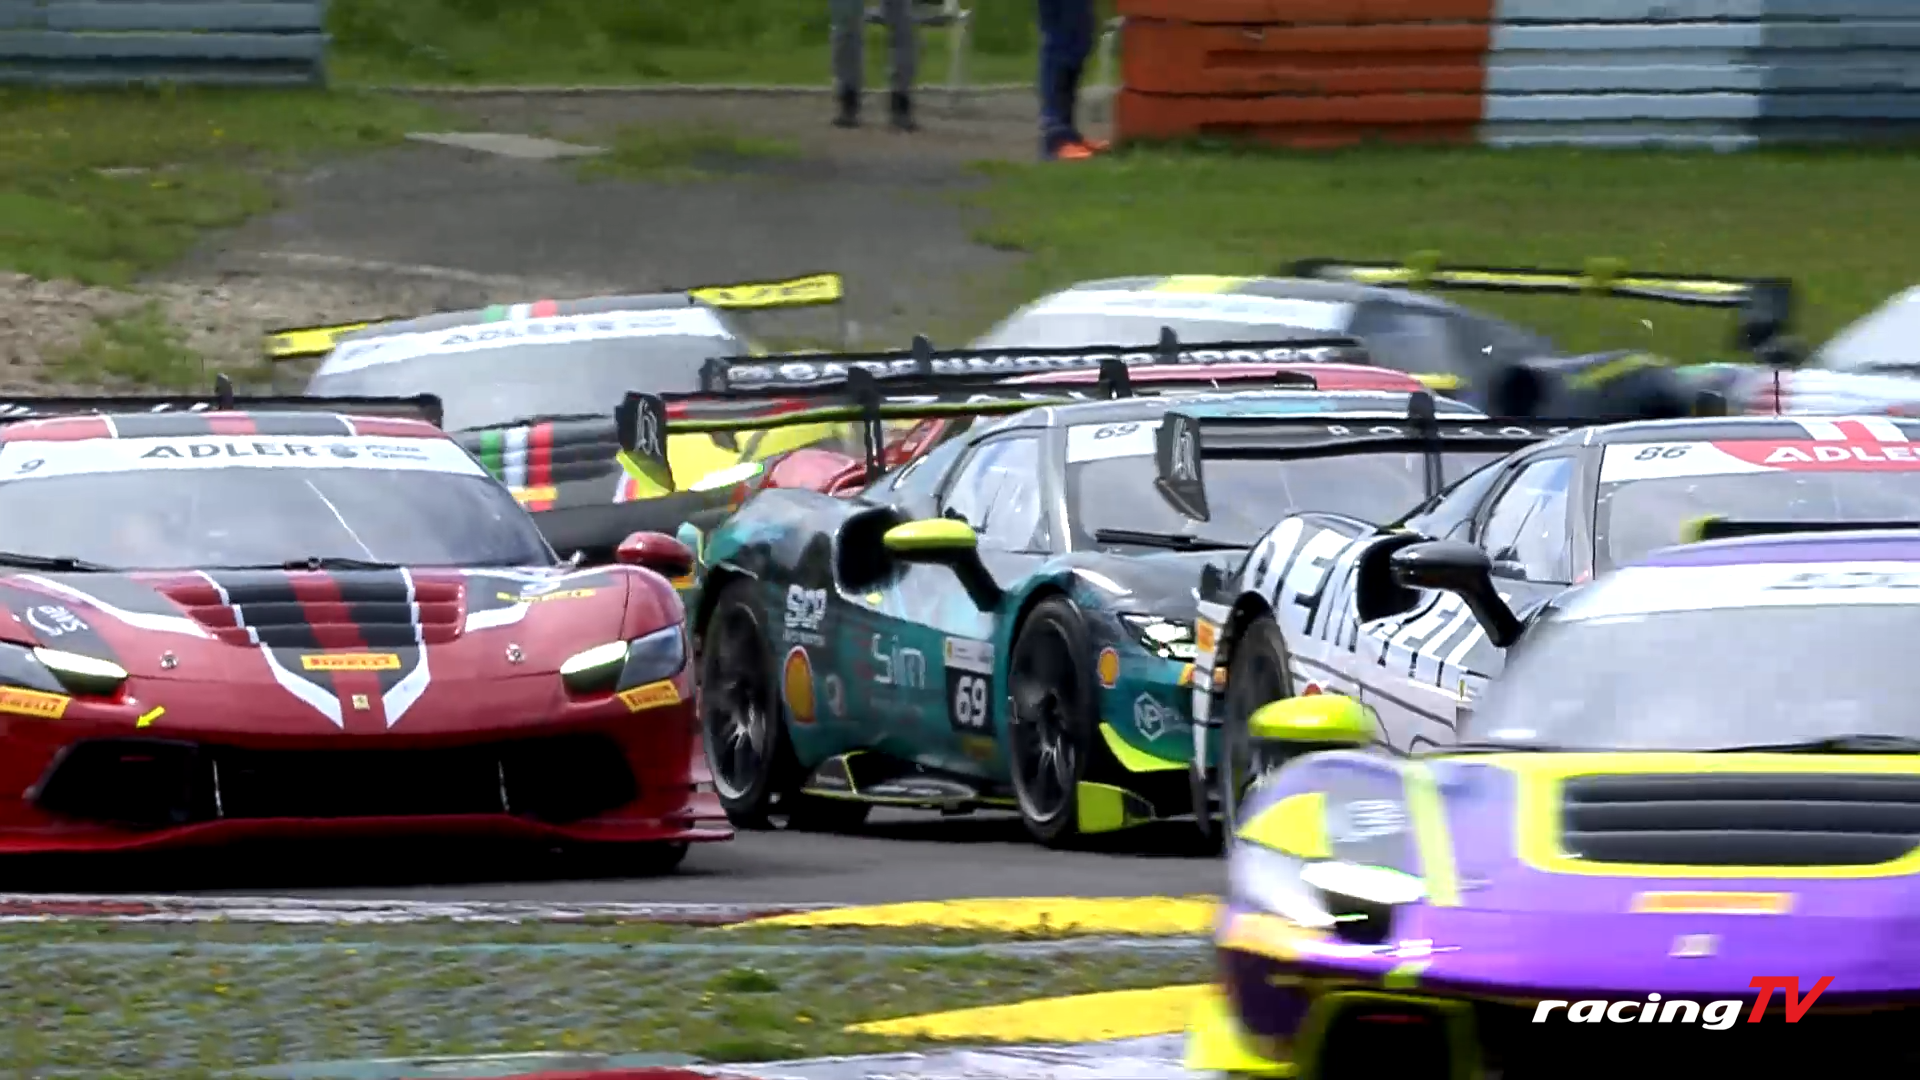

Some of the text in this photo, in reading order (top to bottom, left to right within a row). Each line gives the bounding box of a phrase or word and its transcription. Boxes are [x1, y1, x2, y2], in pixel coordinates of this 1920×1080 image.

[1094, 424, 1140, 440] 69
[140, 442, 317, 459] ADLER
[1634, 445, 1692, 461] 86
[1763, 445, 1920, 463] ADLE
[15, 458, 45, 474] 9
[955, 675, 987, 727] 69
